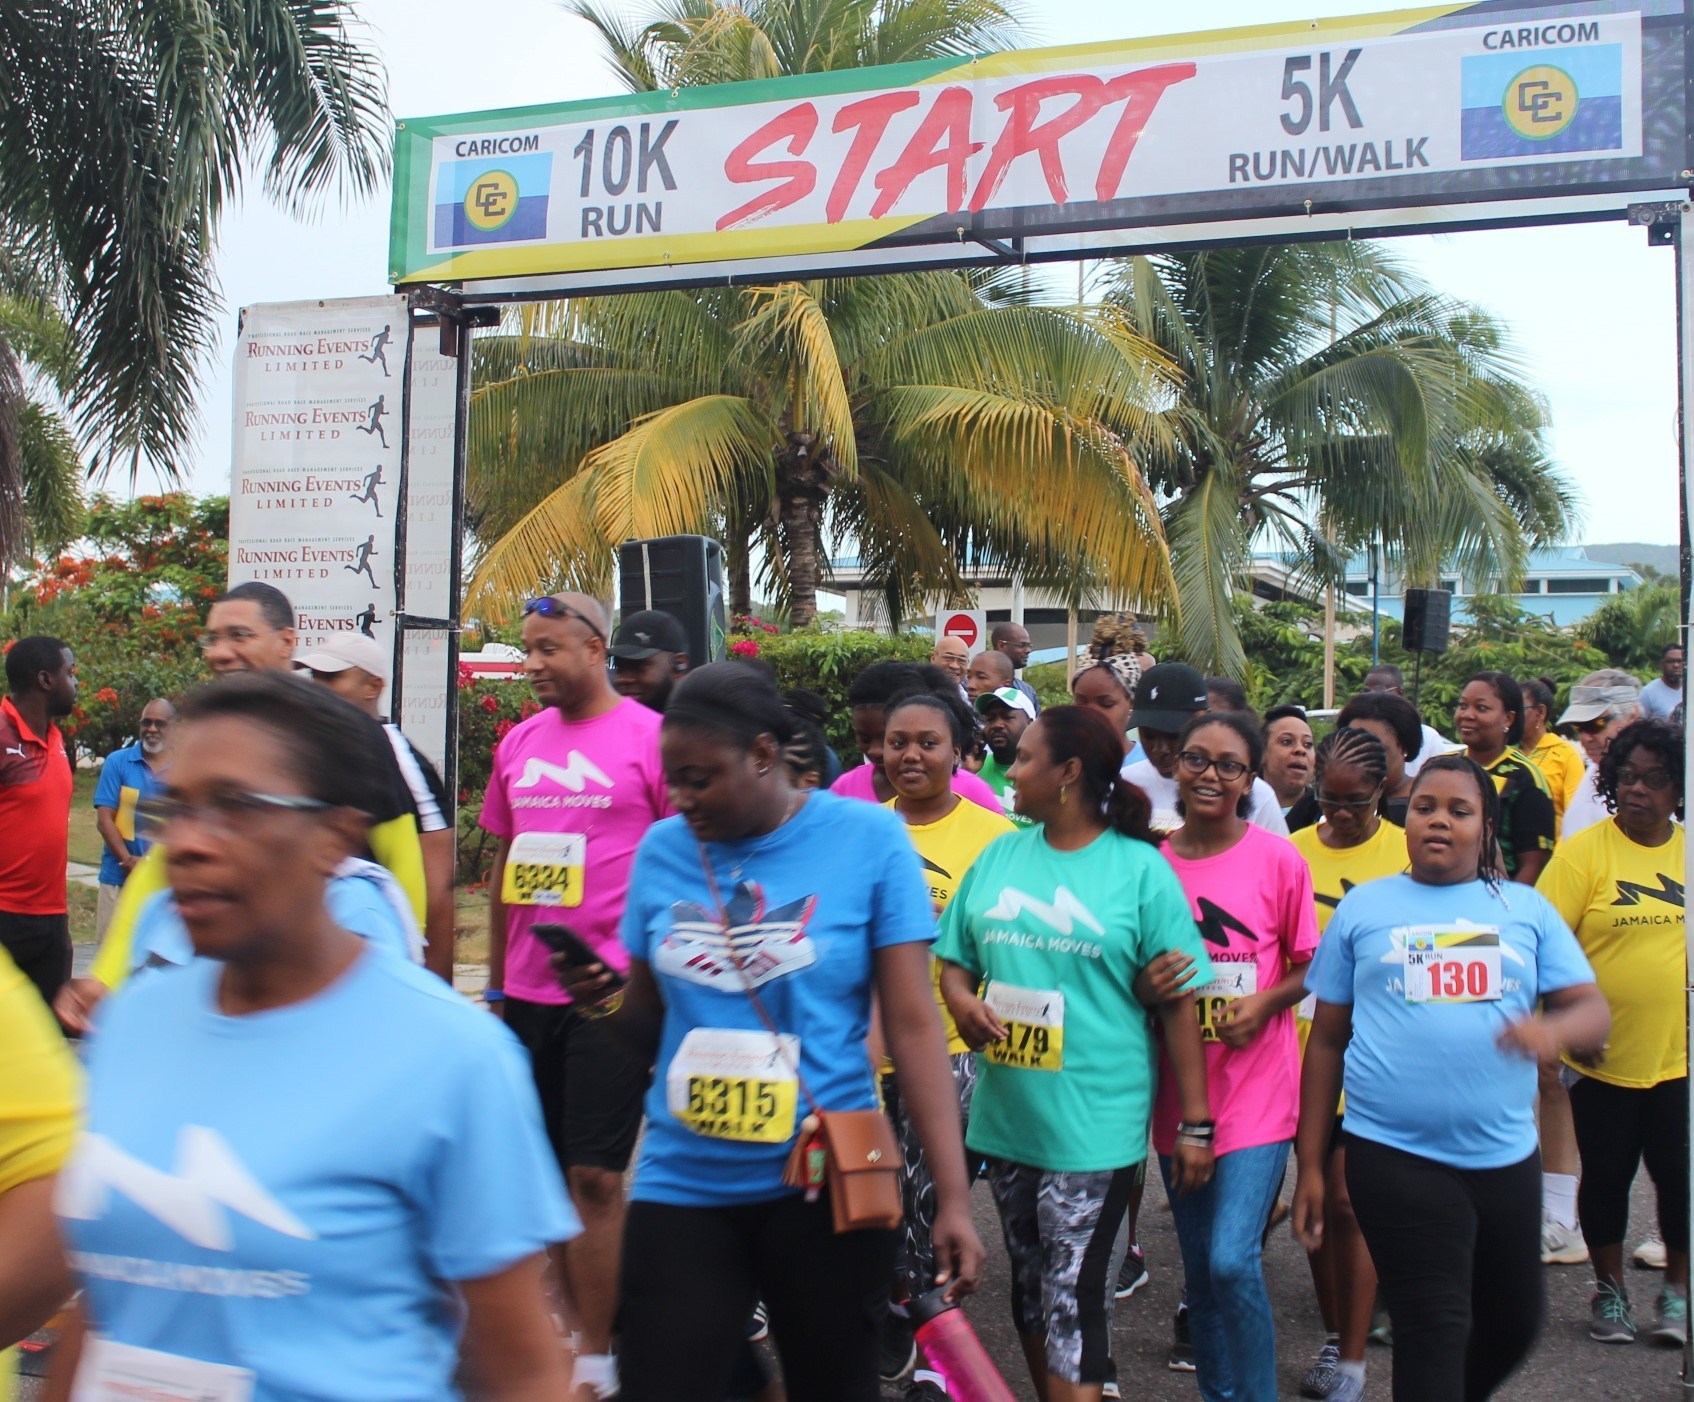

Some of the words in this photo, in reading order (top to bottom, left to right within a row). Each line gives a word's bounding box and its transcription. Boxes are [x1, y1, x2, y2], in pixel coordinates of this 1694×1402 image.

[1483, 21, 1599, 50] CARICOM
[1279, 48, 1364, 136] 5K
[455, 134, 539, 158] CARICOM
[715, 62, 1197, 231] START
[573, 119, 680, 198] 10K
[1229, 136, 1430, 183] RUN/WALK
[581, 202, 662, 238] RUN
[246, 342, 314, 358] RUNNING
[317, 338, 369, 355] EVENTS
[265, 360, 343, 372] LIMITED
[245, 411, 308, 427] RUNNING
[312, 408, 366, 424] EVENTS
[261, 430, 341, 441] LIMITED
[241, 478, 301, 494] RUNNING
[305, 475, 361, 492] EVENTS
[257, 497, 333, 509] LIMITED
[237, 547, 298, 564] RUNNING
[301, 546, 354, 562] EVENTS
[253, 568, 329, 579] LIMITED
[298, 613, 354, 630] EVENTS
[1612, 915, 1672, 928] JAMAICA
[983, 928, 1043, 949] JAMAICA
[1048, 937, 1102, 959] MOVES
[1209, 952, 1258, 963] MOVES
[1409, 954, 1424, 965] 5K
[1425, 952, 1443, 960] RUN
[1427, 961, 1488, 996] 130
[993, 1049, 1041, 1066] WALK
